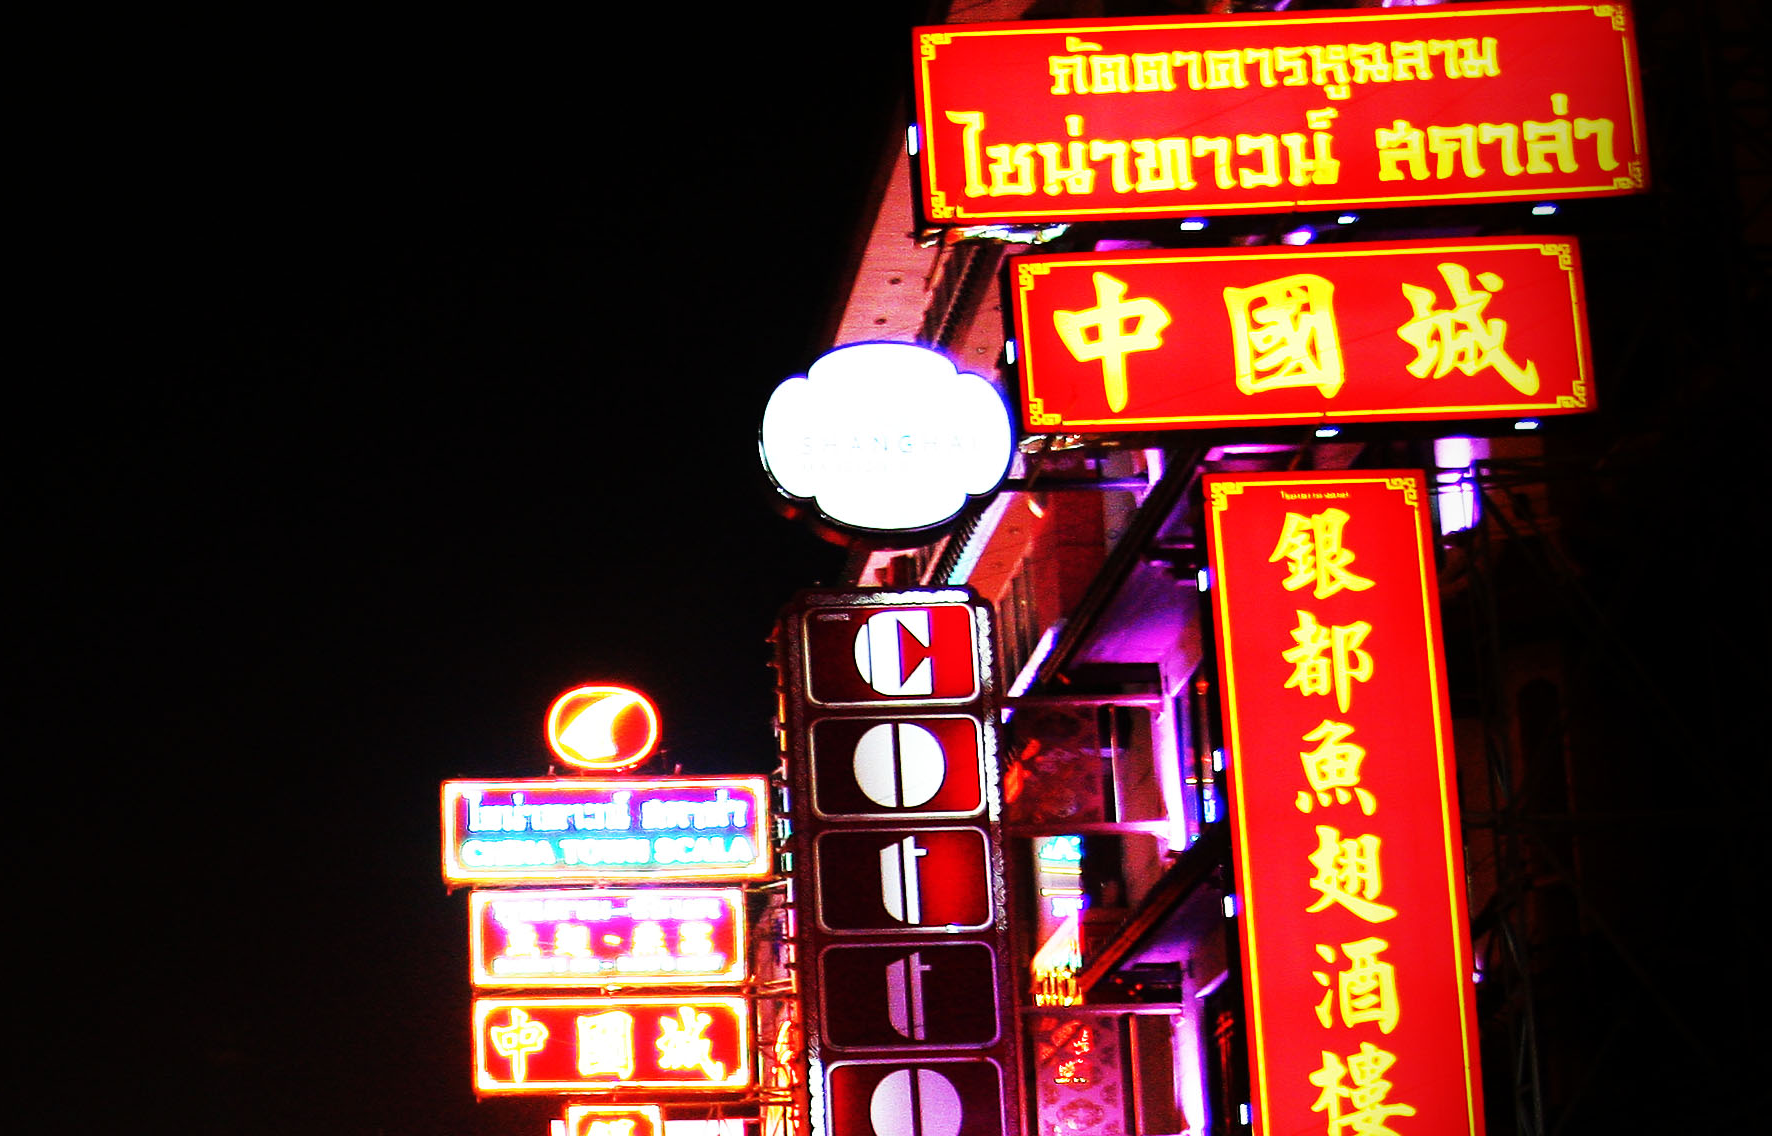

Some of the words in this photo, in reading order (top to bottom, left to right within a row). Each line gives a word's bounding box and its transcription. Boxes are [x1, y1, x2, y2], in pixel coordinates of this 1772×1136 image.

[946, 108, 1340, 198] ไชน่าทาวน์
[1375, 93, 1620, 182] สกาล่า
[1053, 262, 1540, 413] 中國城
[490, 1007, 726, 1083] 中國城
